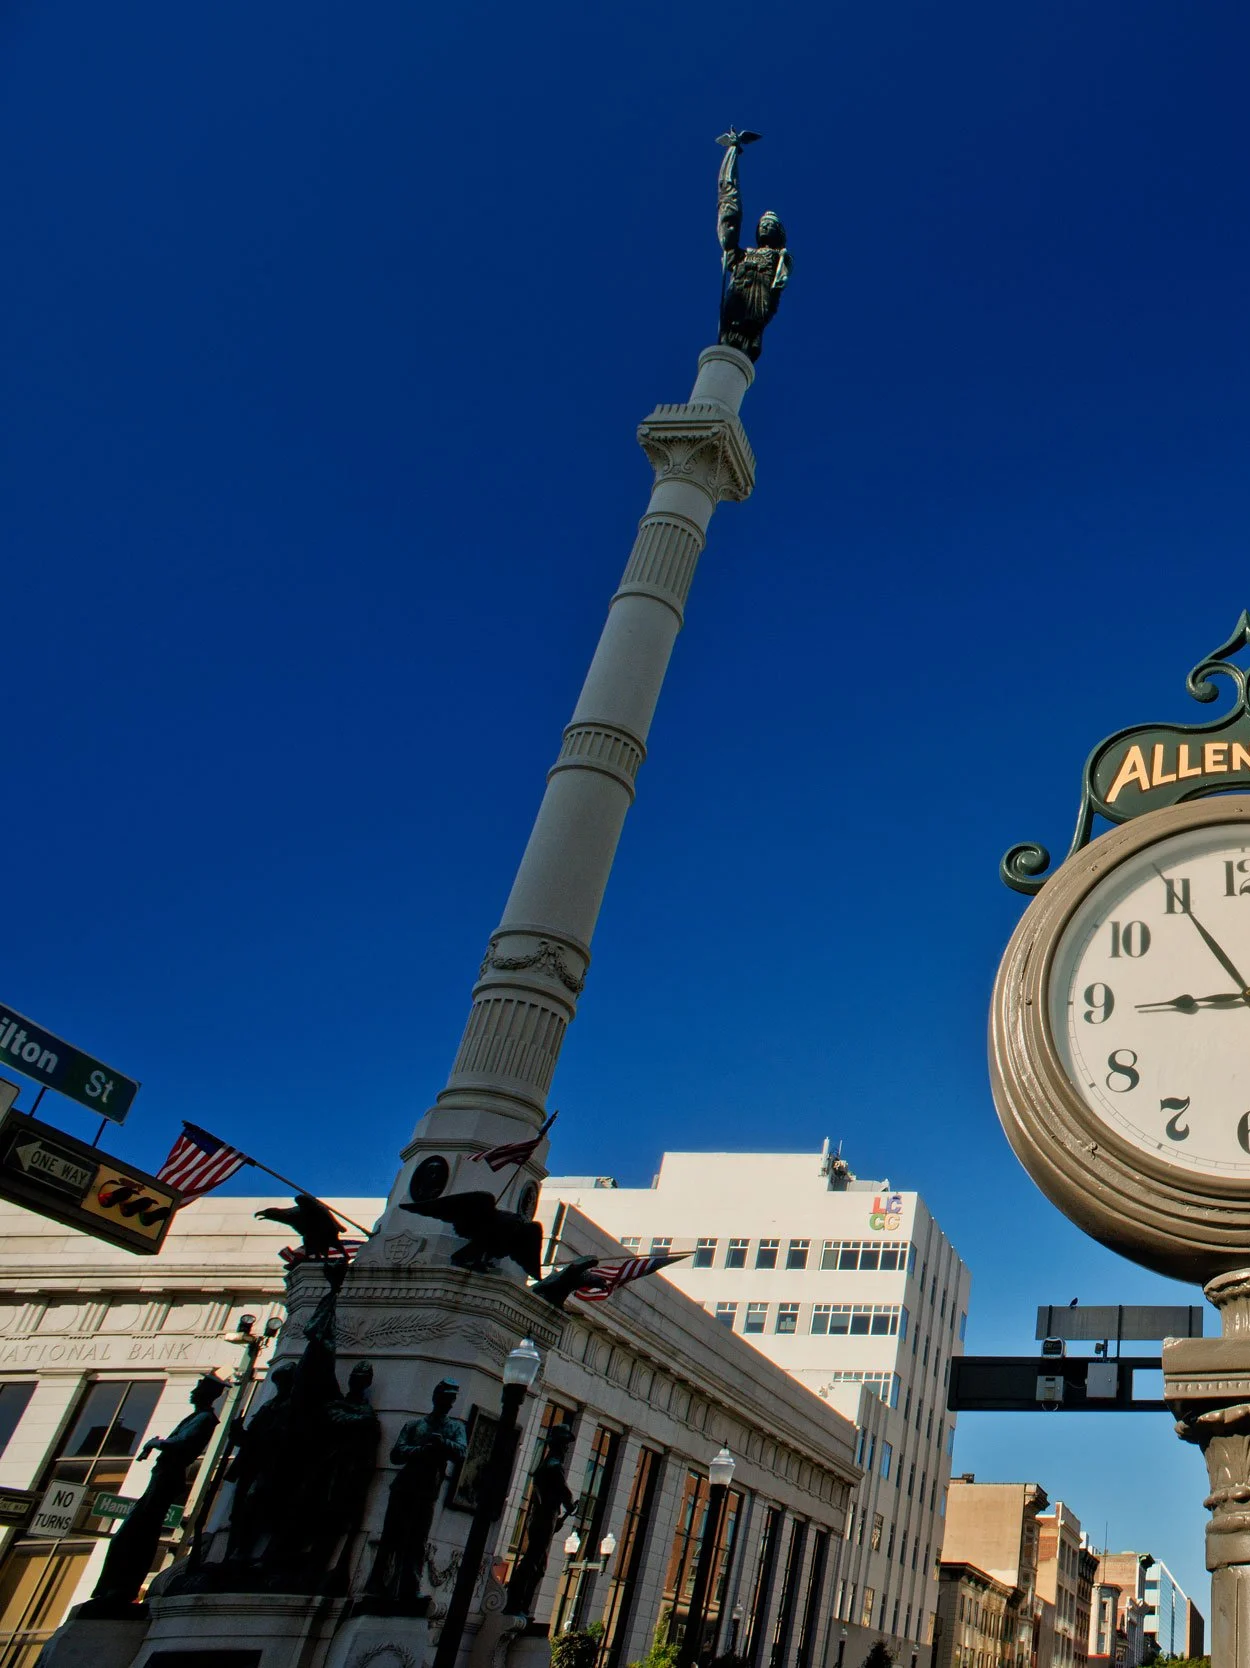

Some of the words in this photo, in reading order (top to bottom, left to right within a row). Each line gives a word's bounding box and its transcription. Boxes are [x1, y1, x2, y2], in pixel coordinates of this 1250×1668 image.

[1164, 877, 1194, 915] 11
[1108, 920, 1152, 959] 10
[1083, 982, 1115, 1025] 9
[84, 1070, 114, 1103] St
[1105, 1048, 1140, 1092] 8
[1160, 1096, 1191, 1142] 7
[30, 1150, 59, 1173] ONE
[61, 1163, 89, 1187] WAY
[127, 1343, 192, 1362] BANK
[52, 1489, 75, 1508] NO
[35, 1513, 72, 1531] TURNS
